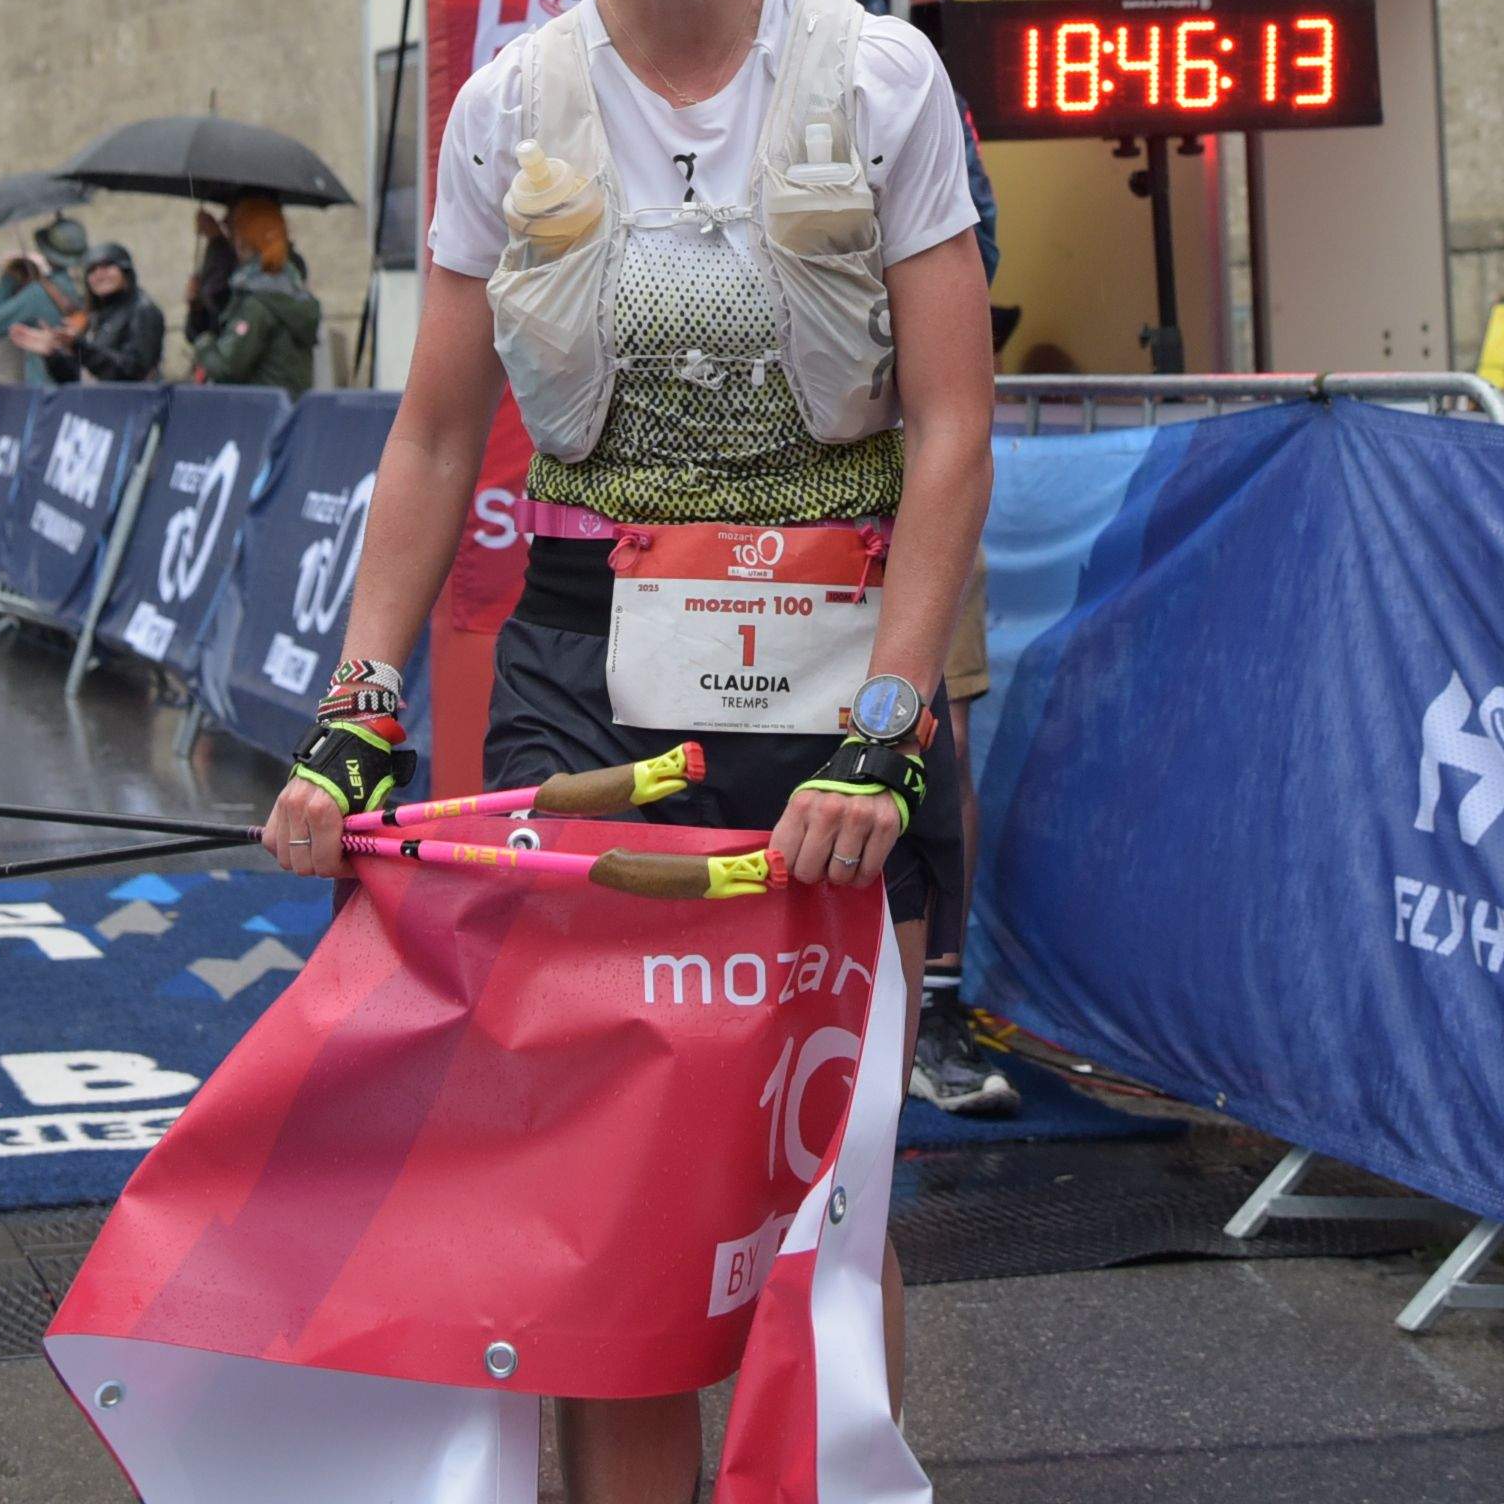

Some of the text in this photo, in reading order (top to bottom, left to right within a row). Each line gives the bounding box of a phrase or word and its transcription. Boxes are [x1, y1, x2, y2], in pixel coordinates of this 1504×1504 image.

[1026, 17, 1334, 113] 18:46:13
[717, 531, 754, 543] mozart
[731, 530, 785, 567] 100
[638, 583, 660, 593] 2025
[684, 596, 766, 615] mozart
[774, 596, 813, 616] 100
[738, 624, 756, 667] 1
[699, 673, 791, 693] CLAUDIA
[721, 696, 769, 709] TREMPS
[347, 759, 364, 800] LEKI
[424, 796, 478, 820] LEKI
[454, 843, 518, 868] LEKI
[1395, 875, 1467, 957] FLY
[727, 1242, 759, 1296] BY
